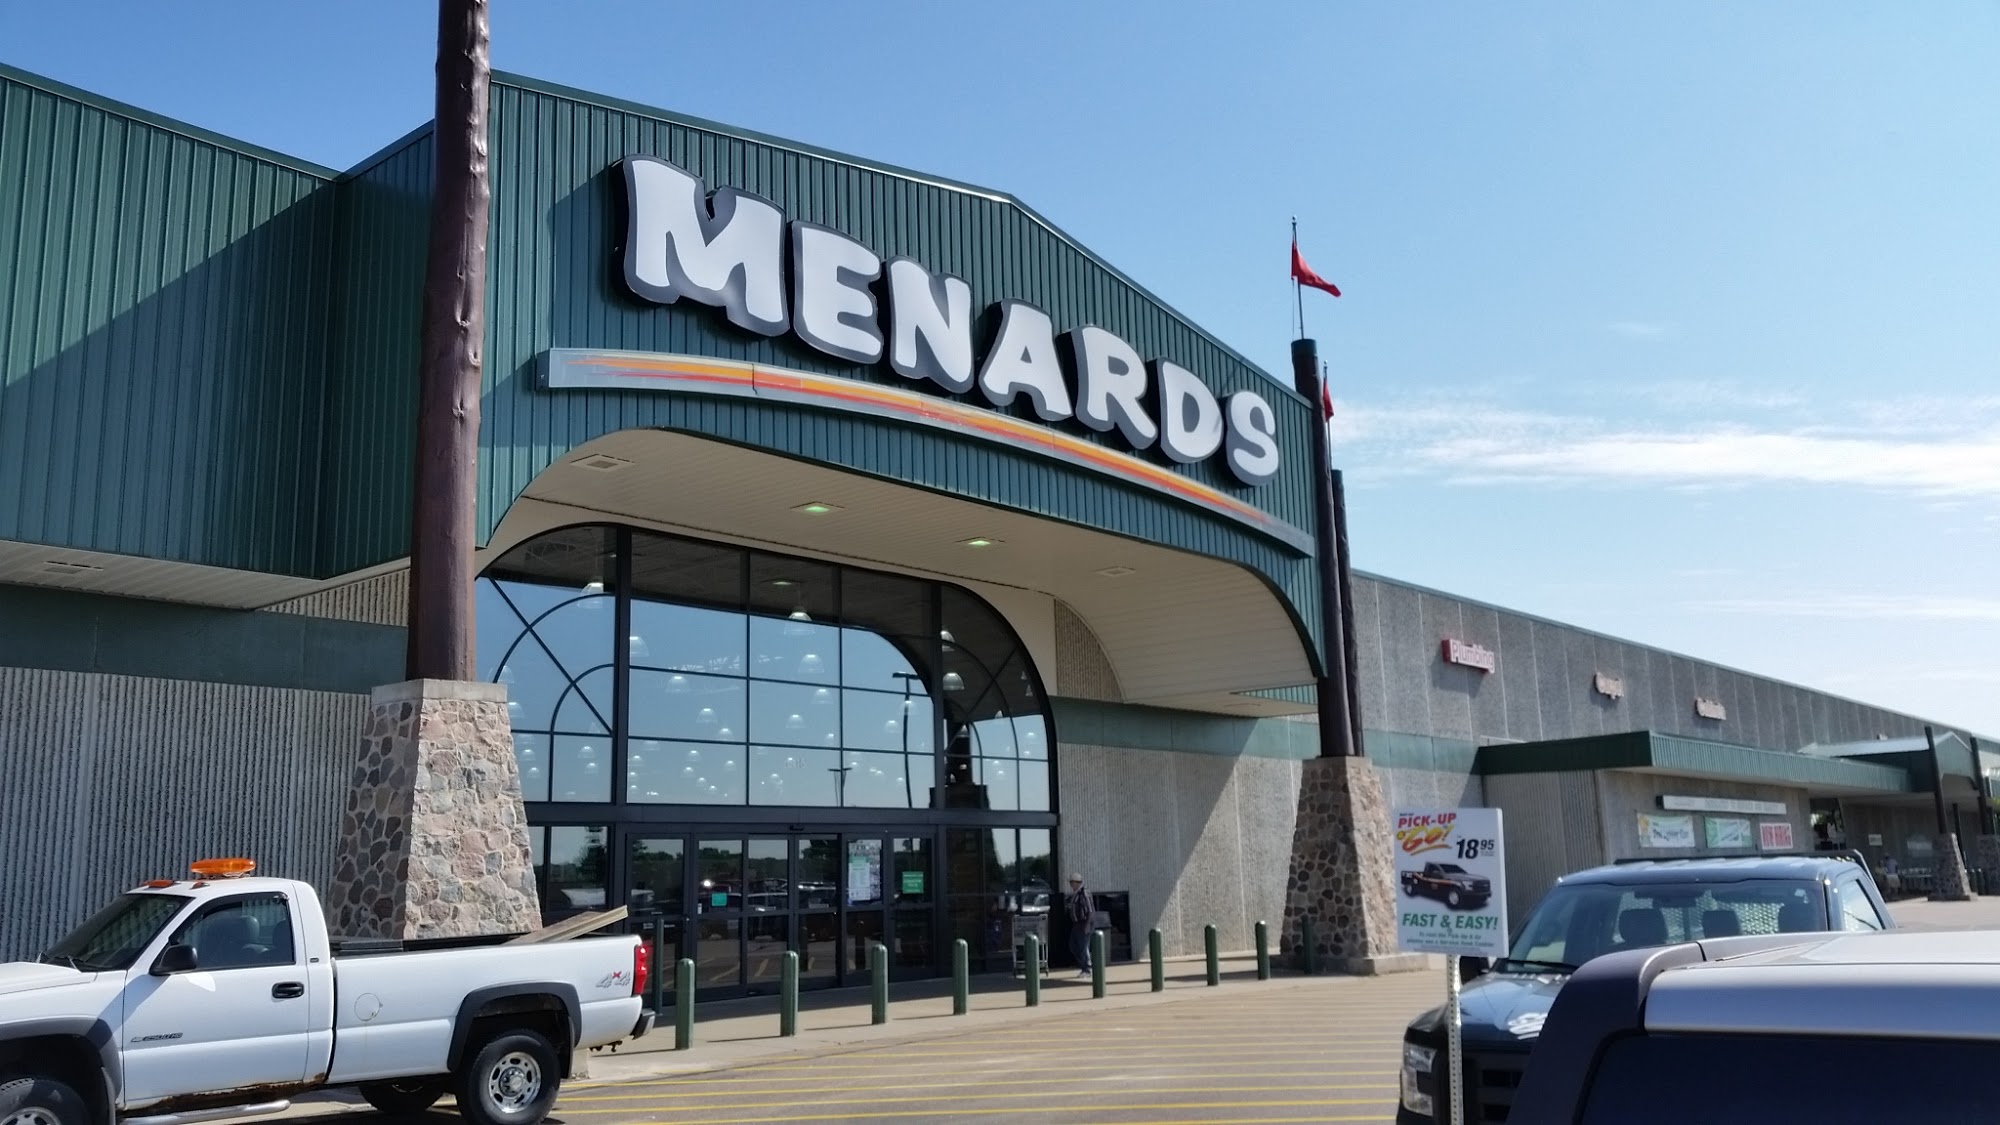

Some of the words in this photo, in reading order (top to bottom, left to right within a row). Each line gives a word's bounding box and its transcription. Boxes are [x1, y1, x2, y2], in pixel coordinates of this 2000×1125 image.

[624, 153, 1280, 487] MENARDS
[1449, 638, 1495, 674] Plumbing
[1398, 812, 1457, 829] PICK-UP
[1402, 913, 1437, 927] FAST
[1440, 914, 1451, 928] &
[1455, 915, 1499, 930] EASY!
